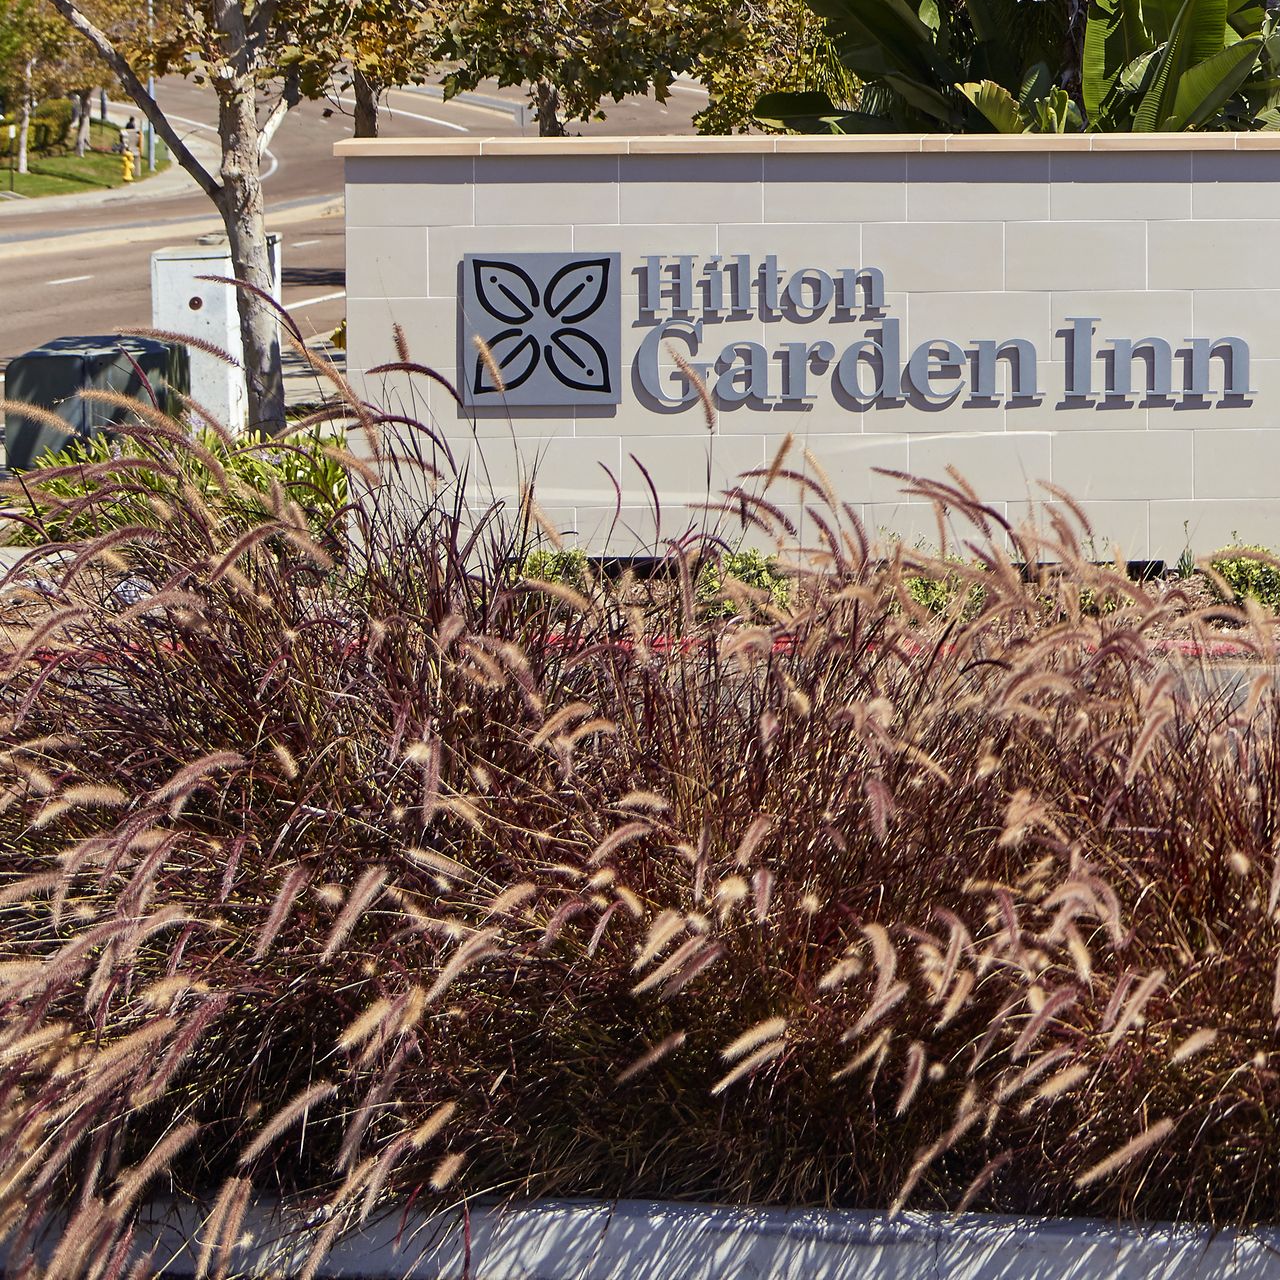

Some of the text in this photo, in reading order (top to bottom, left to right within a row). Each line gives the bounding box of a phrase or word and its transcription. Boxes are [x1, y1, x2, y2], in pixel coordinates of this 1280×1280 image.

[640, 254, 891, 311] Hilton
[638, 317, 1258, 403] Garden Inn
